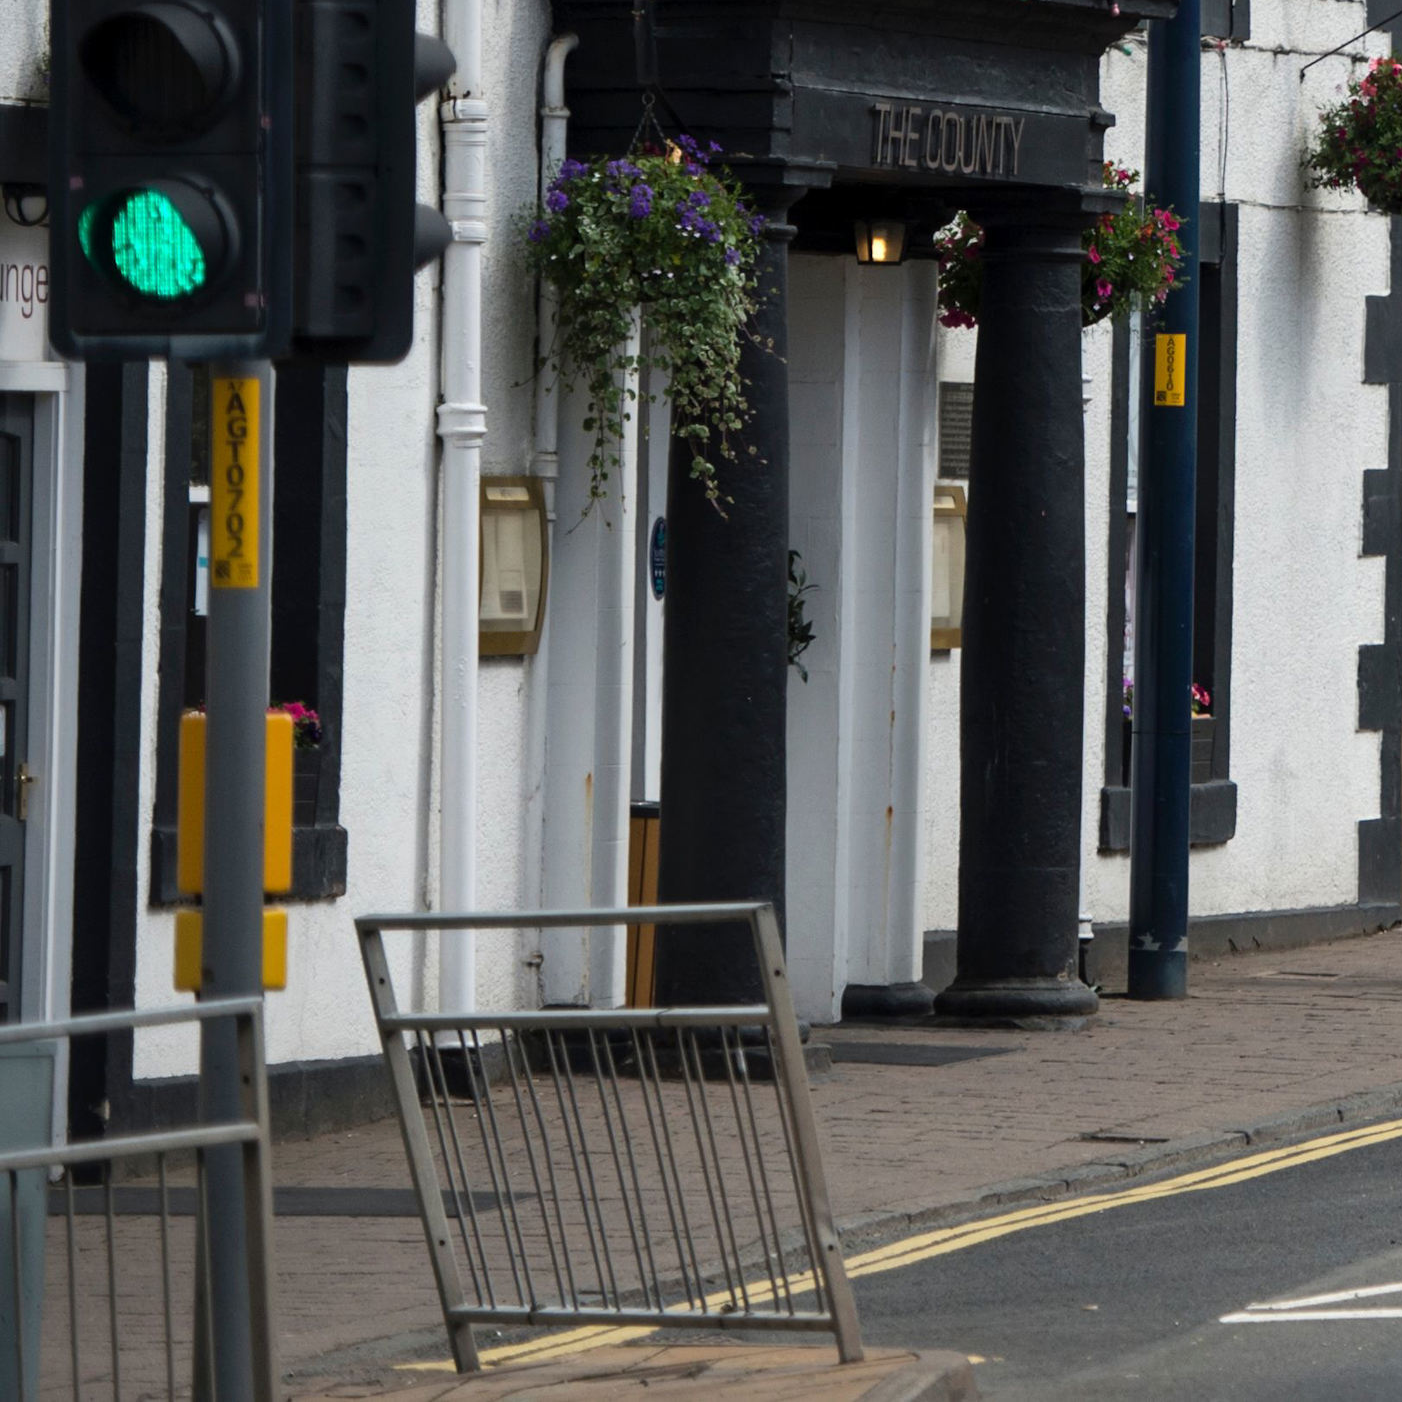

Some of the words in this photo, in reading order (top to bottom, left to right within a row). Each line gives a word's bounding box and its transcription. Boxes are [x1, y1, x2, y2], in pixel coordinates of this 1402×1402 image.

[874, 102, 922, 167] THE
[925, 108, 1025, 175] COUNTY
[225, 392, 248, 559] AGT0702
